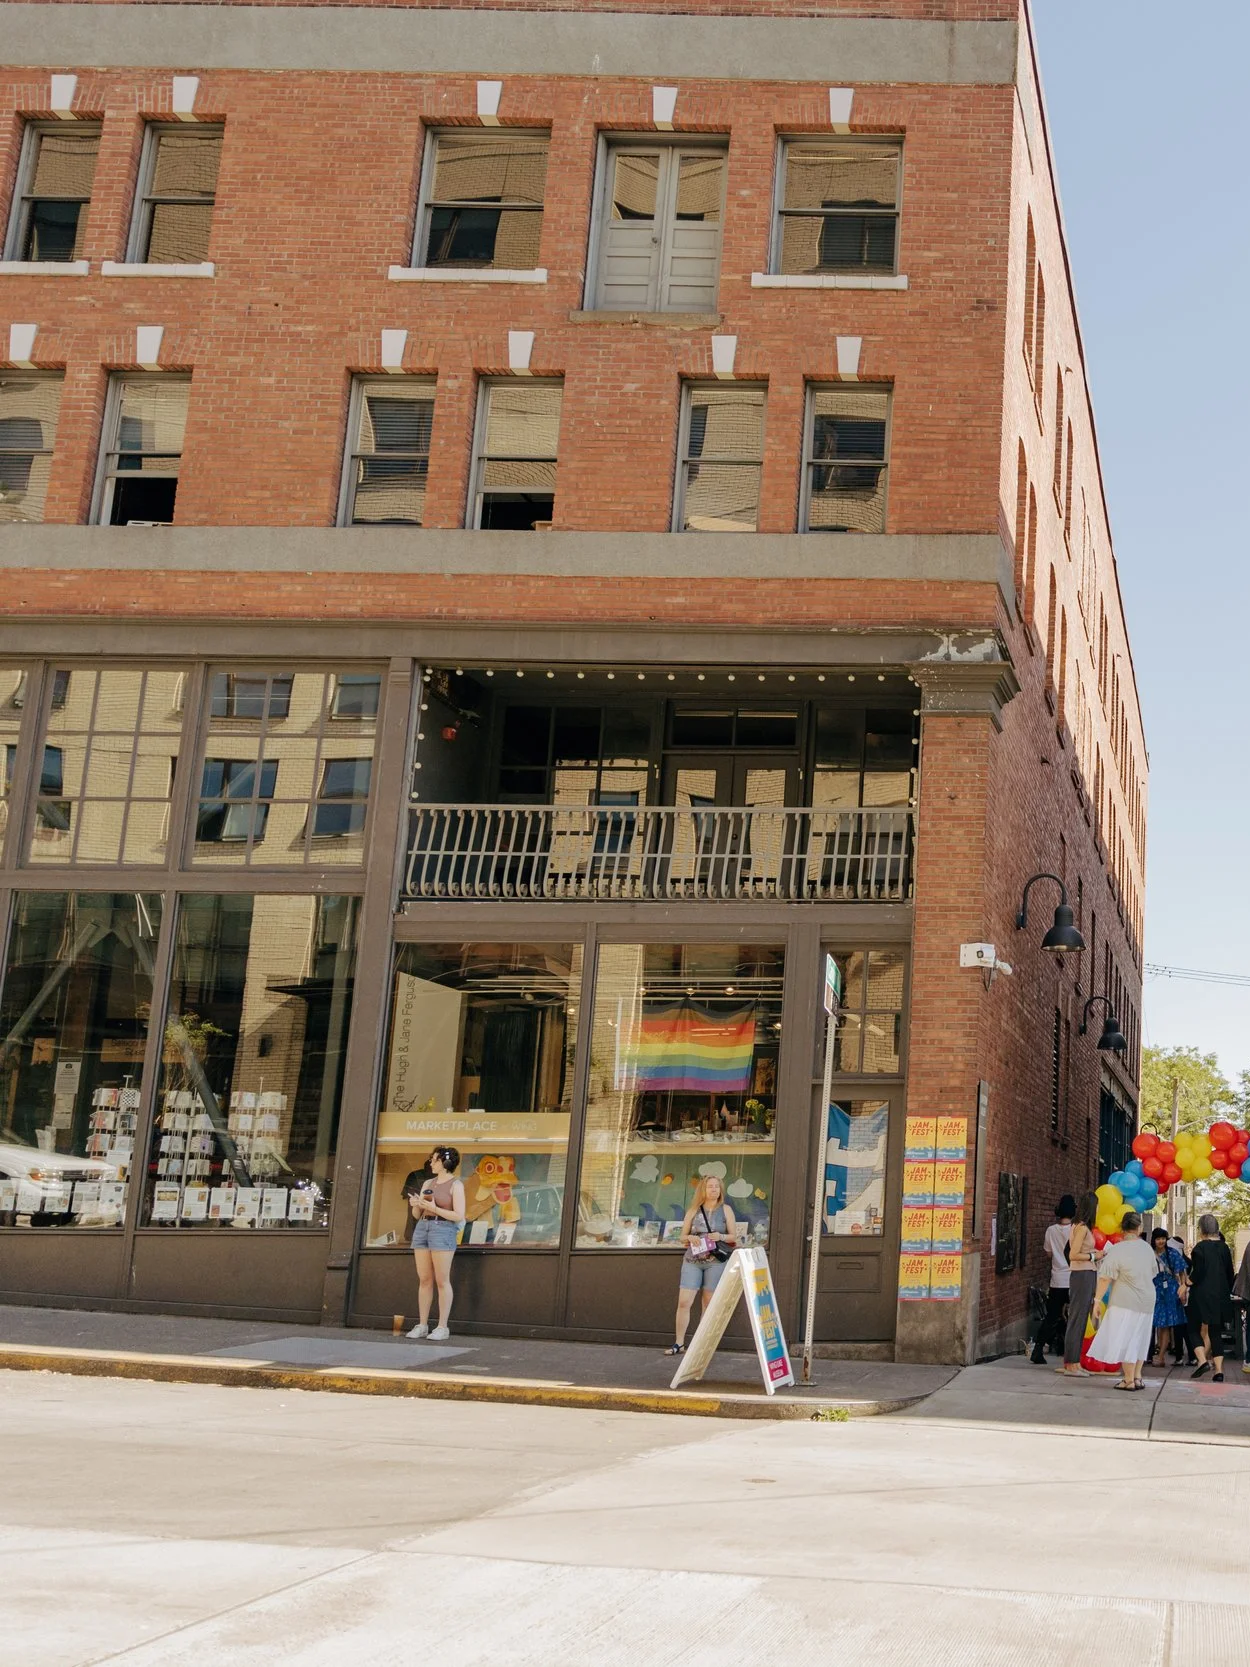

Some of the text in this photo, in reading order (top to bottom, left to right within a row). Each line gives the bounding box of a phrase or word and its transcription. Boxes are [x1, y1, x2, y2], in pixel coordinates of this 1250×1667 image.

[400, 1018, 411, 1042] Jane
[399, 1045, 409, 1053] &
[396, 1053, 409, 1082] Hugh
[406, 1120, 498, 1131] MARKETPLACE
